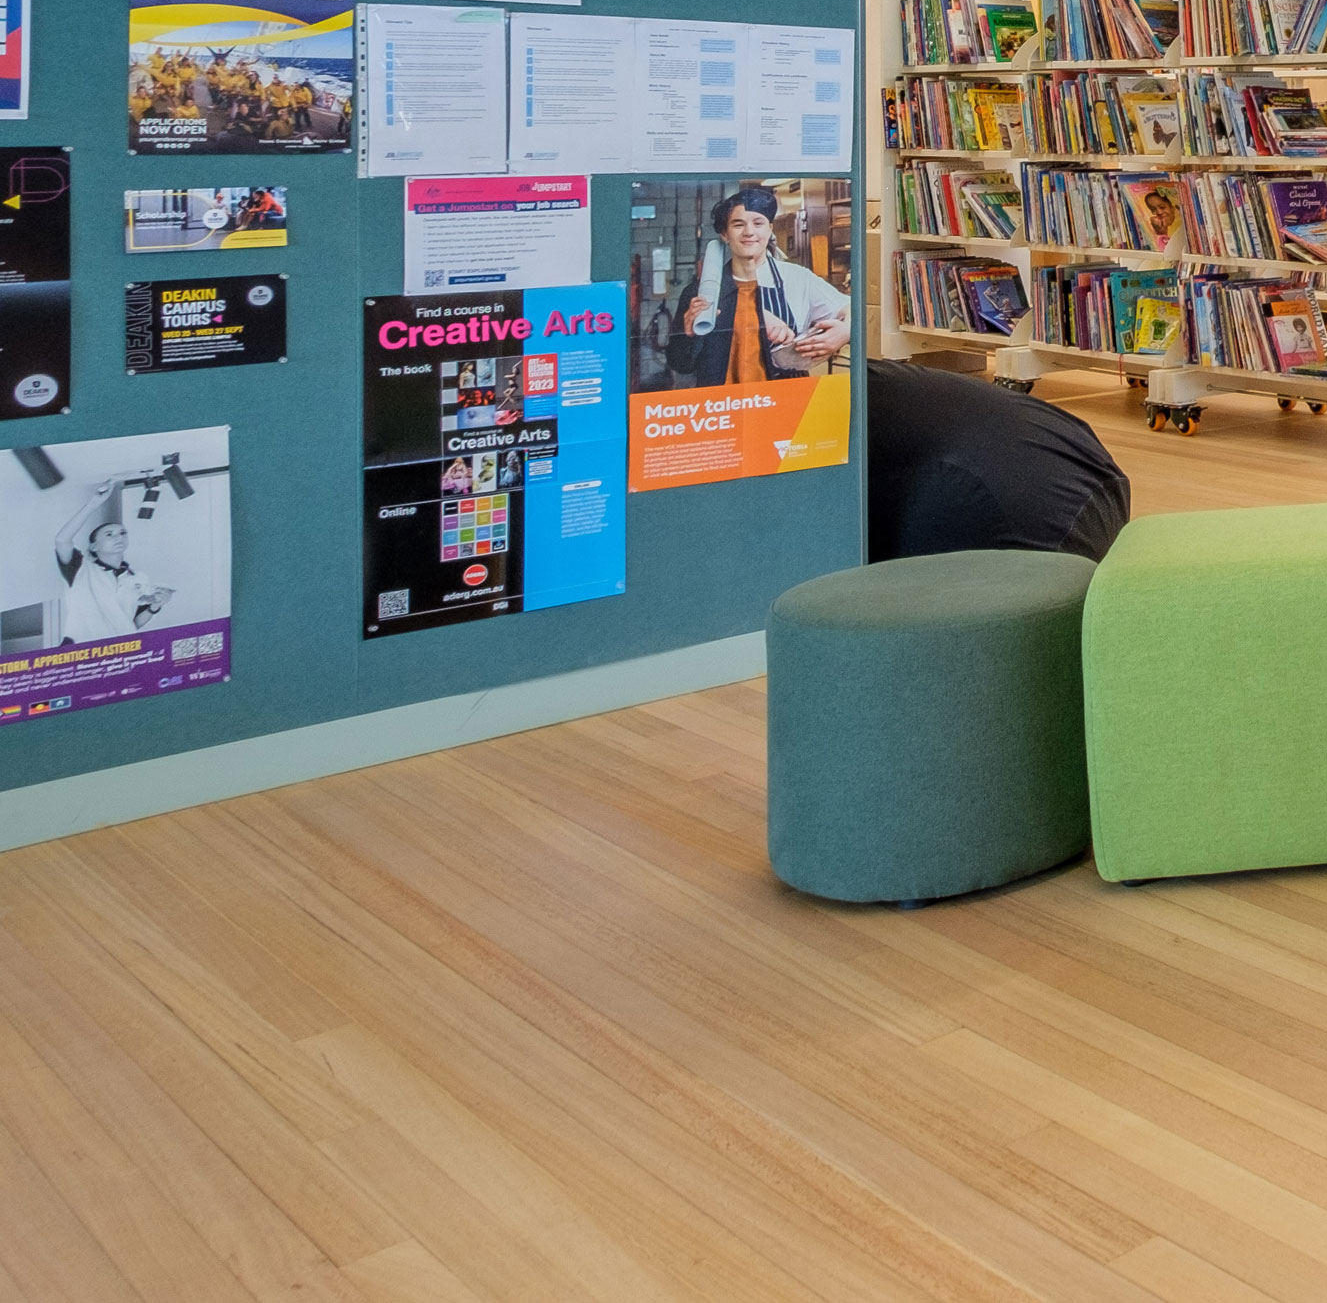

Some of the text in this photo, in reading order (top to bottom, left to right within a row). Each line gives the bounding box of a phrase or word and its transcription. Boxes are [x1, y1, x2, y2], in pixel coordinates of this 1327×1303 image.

[139, 118, 208, 126] APPLICATIONS
[139, 125, 208, 135] NOW OPEN
[417, 204, 437, 213] Get
[447, 203, 499, 213] Jumpstart
[516, 201, 536, 211] your
[536, 200, 550, 210] job
[136, 211, 187, 220] Scholarship
[162, 288, 217, 303] DEAKIN
[162, 300, 226, 315] CAMPUS
[416, 303, 504, 319] Find a course in
[1306, 288, 1323, 327] WORLD
[161, 313, 212, 328] TOURS
[378, 309, 615, 350] Creative Arts
[380, 363, 432, 377] The book
[528, 379, 554, 392] 2023
[644, 394, 776, 420] Many talents.
[644, 415, 735, 439] One VCE.
[448, 428, 551, 452] Creative Arts
[378, 505, 418, 519] Online
[33, 650, 90, 669] APPRENTICE
[92, 640, 142, 658] PLASTERER
